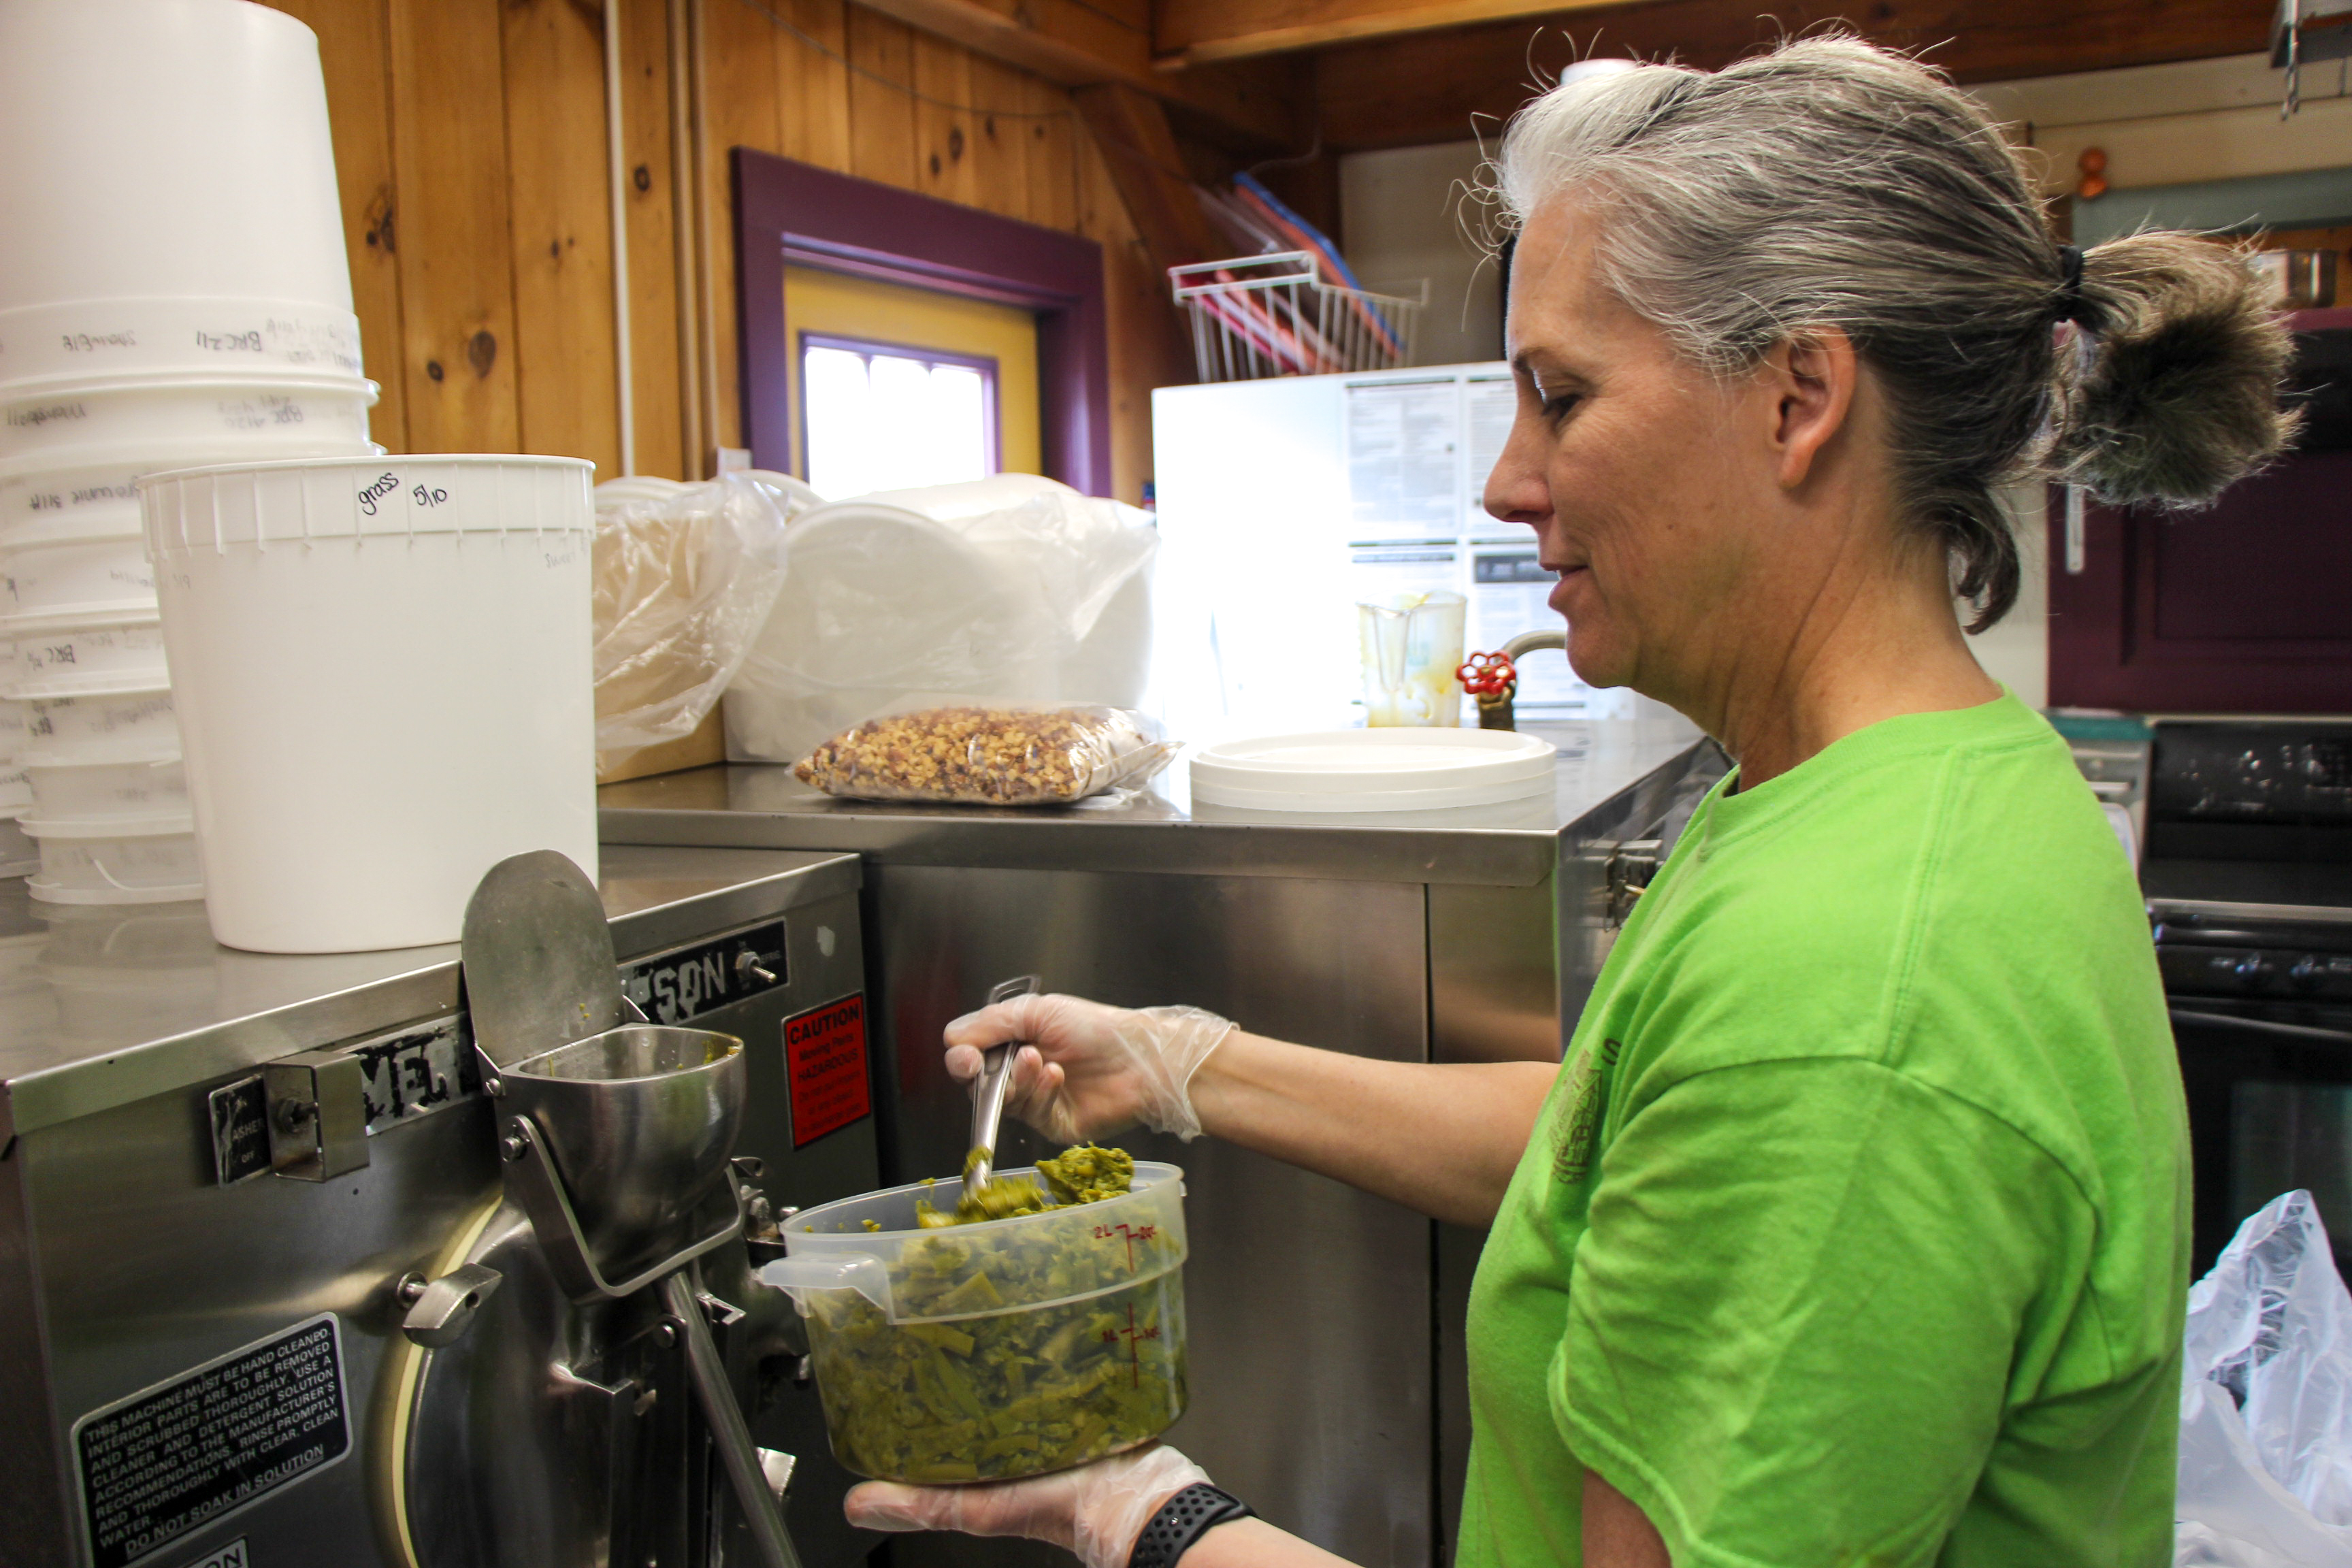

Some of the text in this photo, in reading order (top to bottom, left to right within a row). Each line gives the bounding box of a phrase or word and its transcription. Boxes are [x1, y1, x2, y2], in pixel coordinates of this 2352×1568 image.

[358, 472, 447, 516] grass 5/10
[789, 1004, 859, 1045] CAUTION
[798, 1048, 859, 1083] HAZARDOUS
[87, 1328, 331, 1443] THIS MACHINE MUST BE HAND CLEANED.
[88, 1341, 330, 1458] INTERIOR PARTS ARE TO BE REMOVED
[92, 1451, 122, 1473] AND
[127, 1415, 199, 1457] SCRUBBED
[297, 1362, 319, 1378] USE
[323, 1356, 331, 1365] A
[93, 1369, 334, 1488] CLEANER AND DETERGENT SOLUTION
[240, 1428, 274, 1449] RINSE
[278, 1394, 337, 1432] PROMPTLY
[95, 1383, 336, 1504] ACCORDING TO THE MANUFACTURER'S
[98, 1512, 128, 1534] AND
[133, 1465, 220, 1517] THOROUGHLY
[224, 1450, 256, 1471] WITH
[303, 1408, 338, 1433] CLEAN
[126, 1443, 325, 1555] DO NOT SOAK IN SOLUTION
